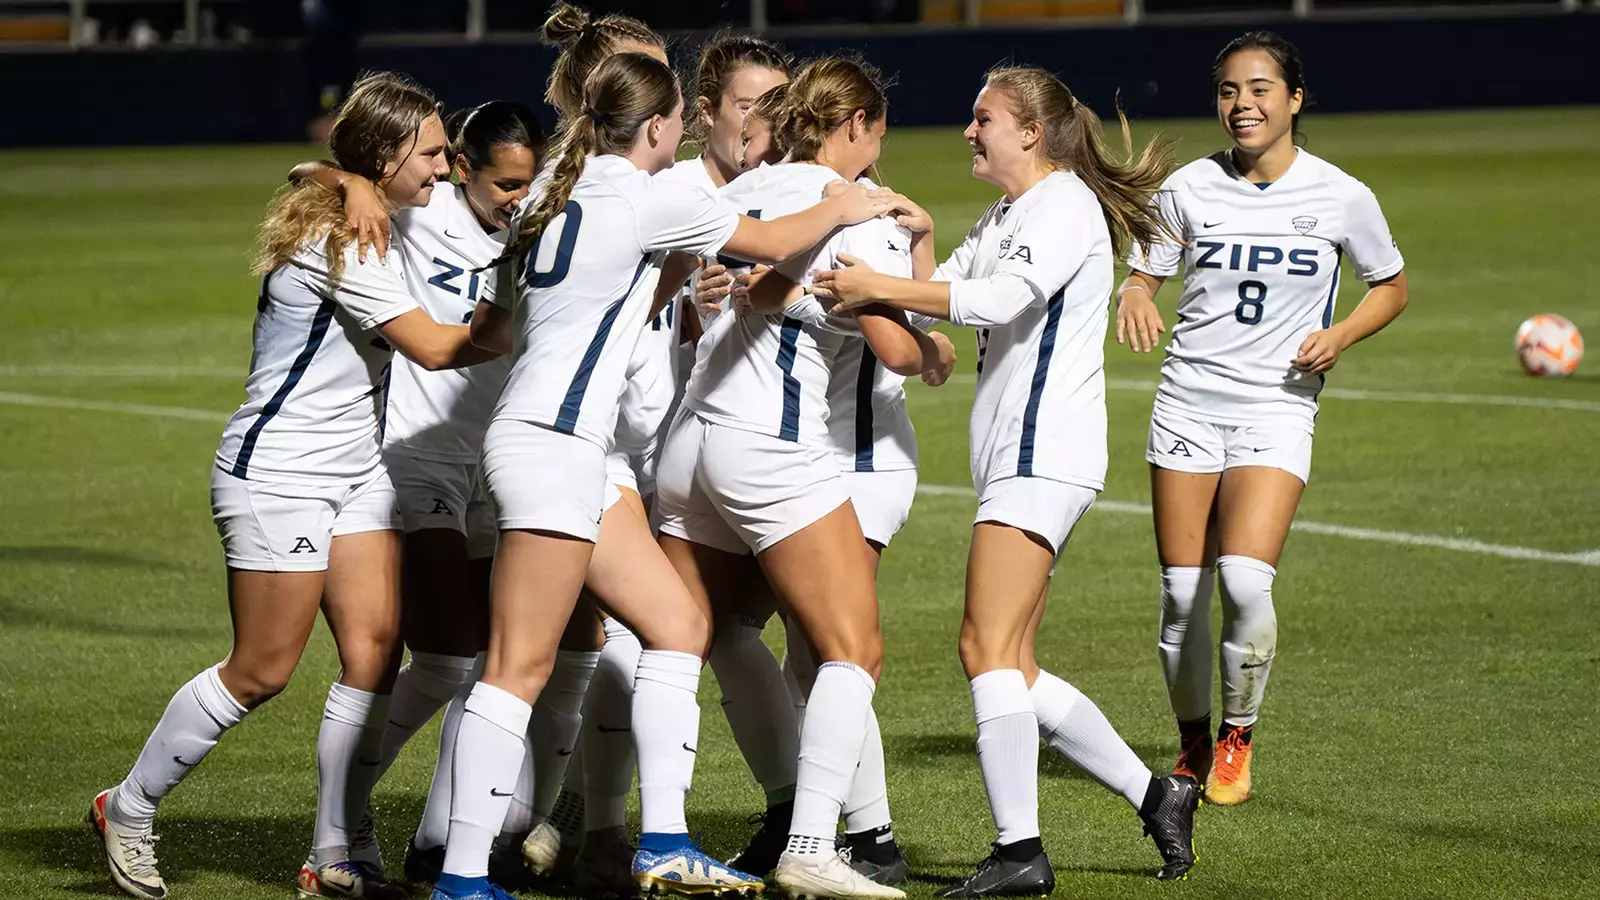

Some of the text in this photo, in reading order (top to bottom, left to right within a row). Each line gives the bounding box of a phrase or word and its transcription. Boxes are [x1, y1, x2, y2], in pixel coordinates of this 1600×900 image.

[1007, 245, 1034, 265] A
[1196, 241, 1318, 276] ZIPS
[1235, 280, 1268, 325] 8
[1168, 440, 1192, 457] A
[430, 498, 453, 515] A
[289, 537, 318, 553] A
